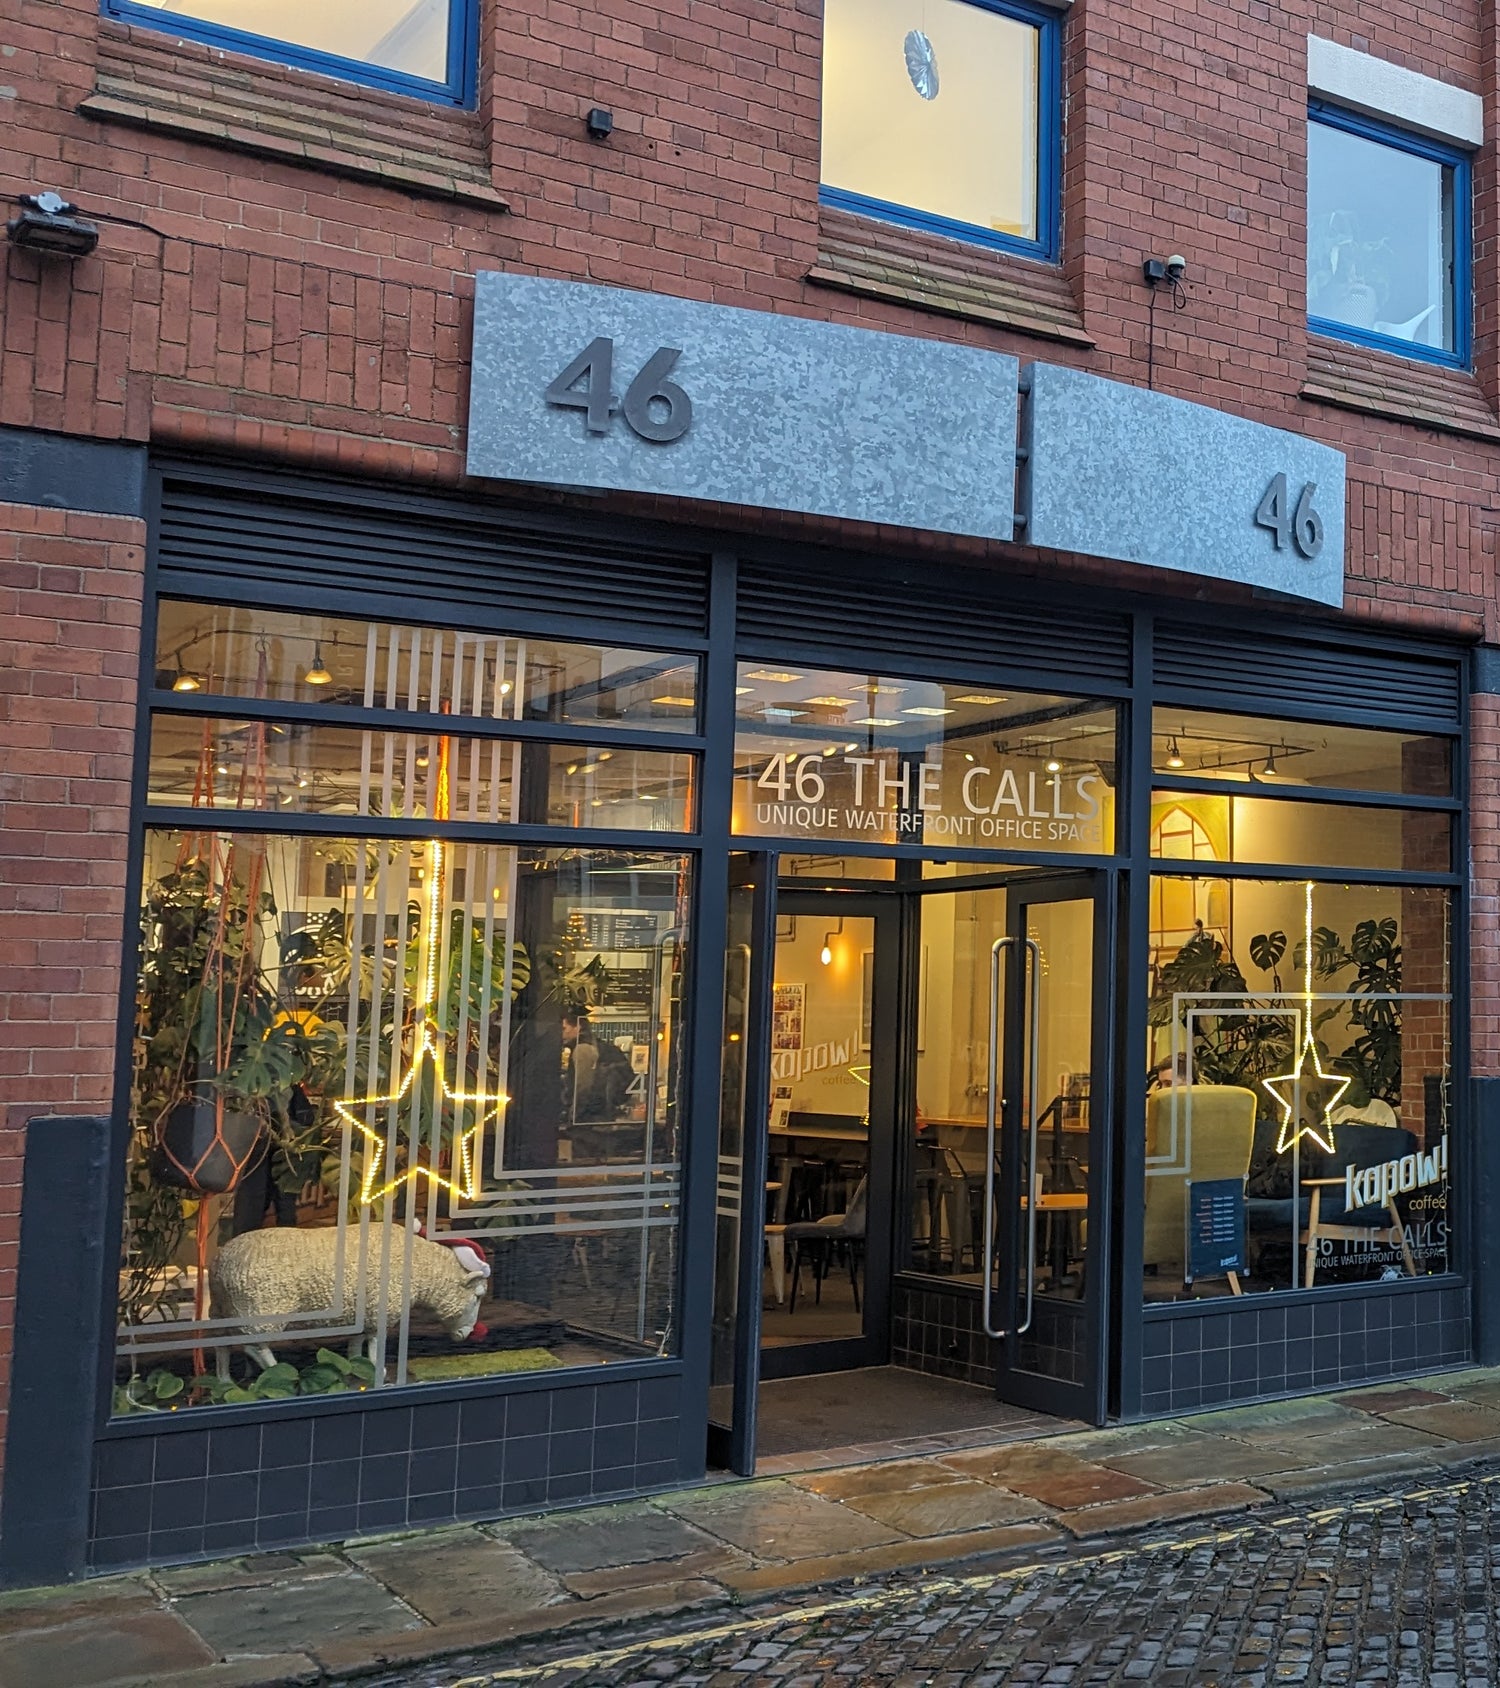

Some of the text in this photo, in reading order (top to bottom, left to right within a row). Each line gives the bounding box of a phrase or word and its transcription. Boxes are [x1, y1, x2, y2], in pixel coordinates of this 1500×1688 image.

[544, 336, 693, 442] 46
[1255, 471, 1324, 559] 46
[757, 752, 1098, 821] 46 THE CALLS
[757, 803, 1100, 843] UNIQUE WATERFRONT OFFICE SPACE
[1344, 1134, 1448, 1213] kapow!
[1409, 1194, 1447, 1210] coffee
[1306, 1221, 1448, 1256] 46 THE CALLS
[1312, 1256, 1339, 1269] NIQUE
[1341, 1250, 1394, 1266] WATERFRONT
